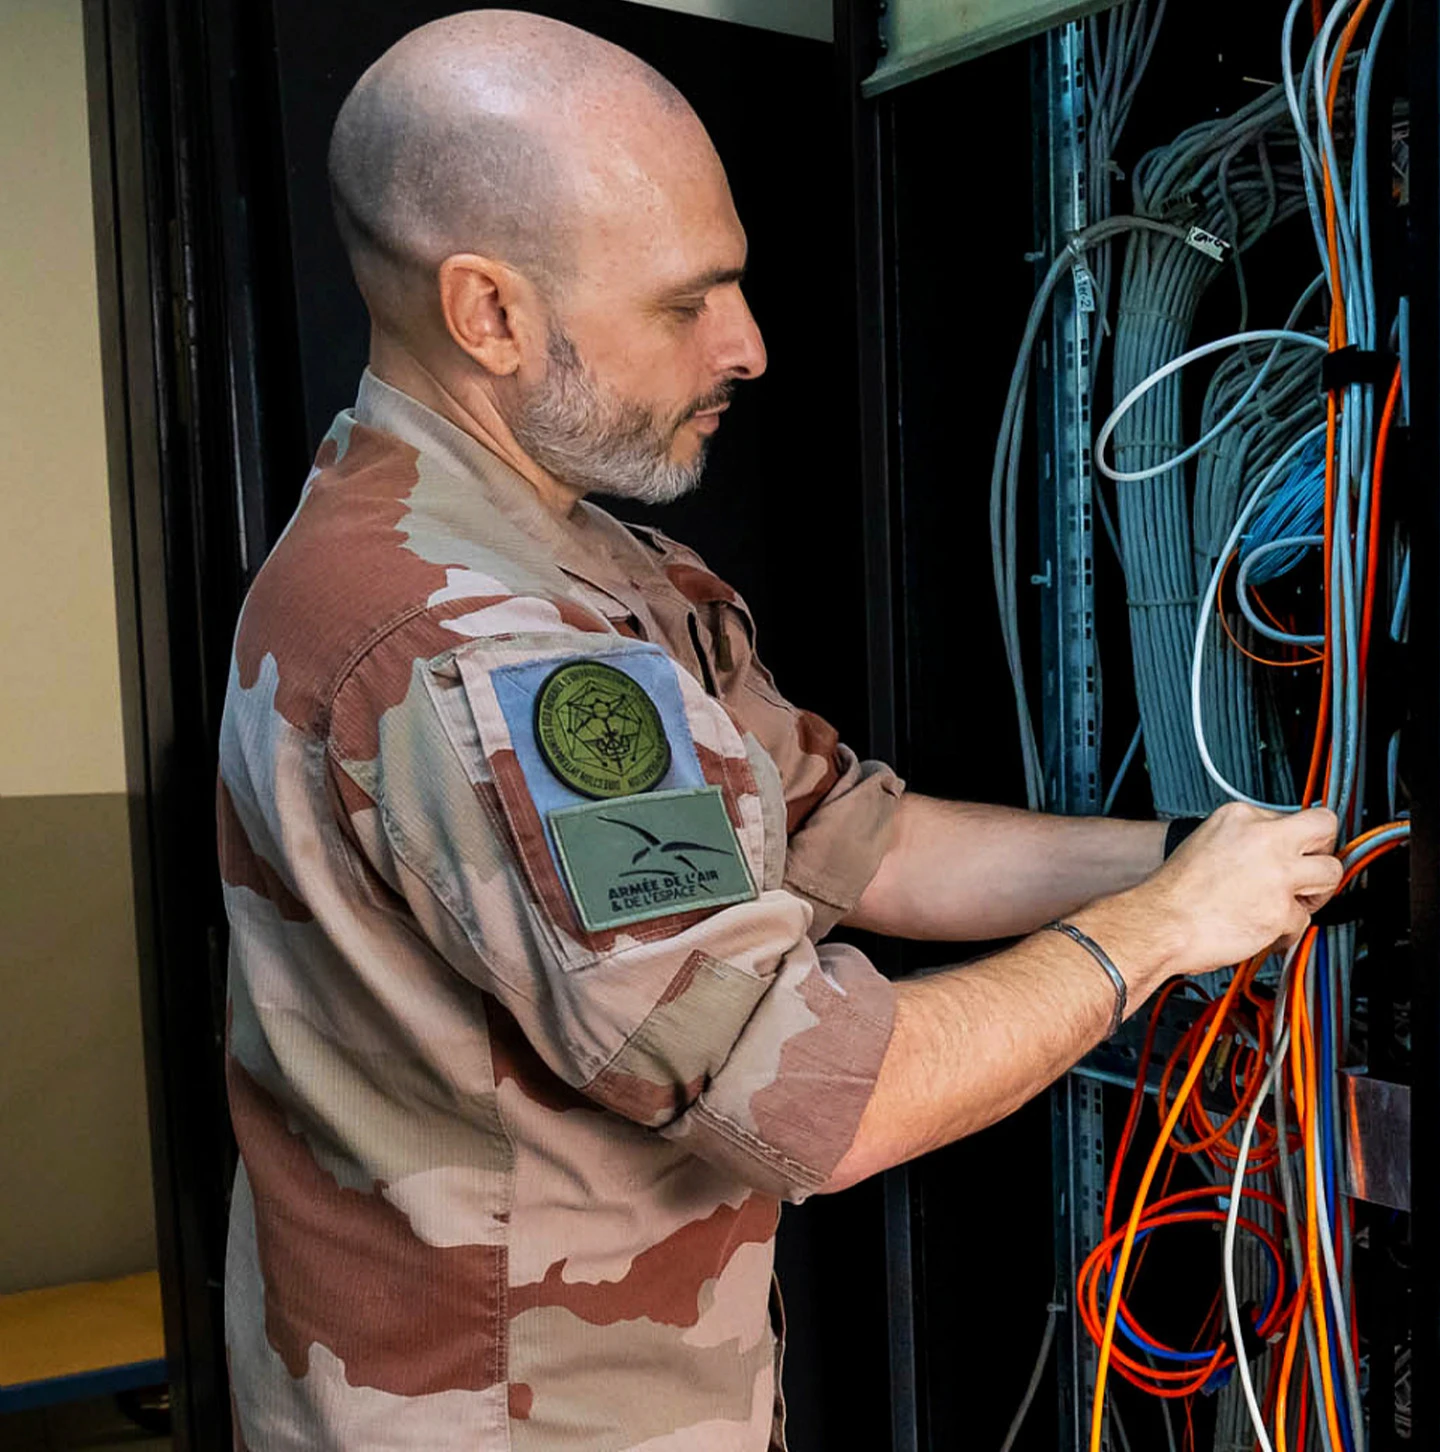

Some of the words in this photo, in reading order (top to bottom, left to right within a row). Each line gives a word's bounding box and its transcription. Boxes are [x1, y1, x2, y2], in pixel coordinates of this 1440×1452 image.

[608, 877, 660, 900] ARMÉE
[663, 875, 683, 888] DE
[685, 870, 719, 884] L'AIR
[611, 900, 622, 912] &
[624, 897, 642, 909] DE
[643, 885, 697, 906] L'ESPACE
